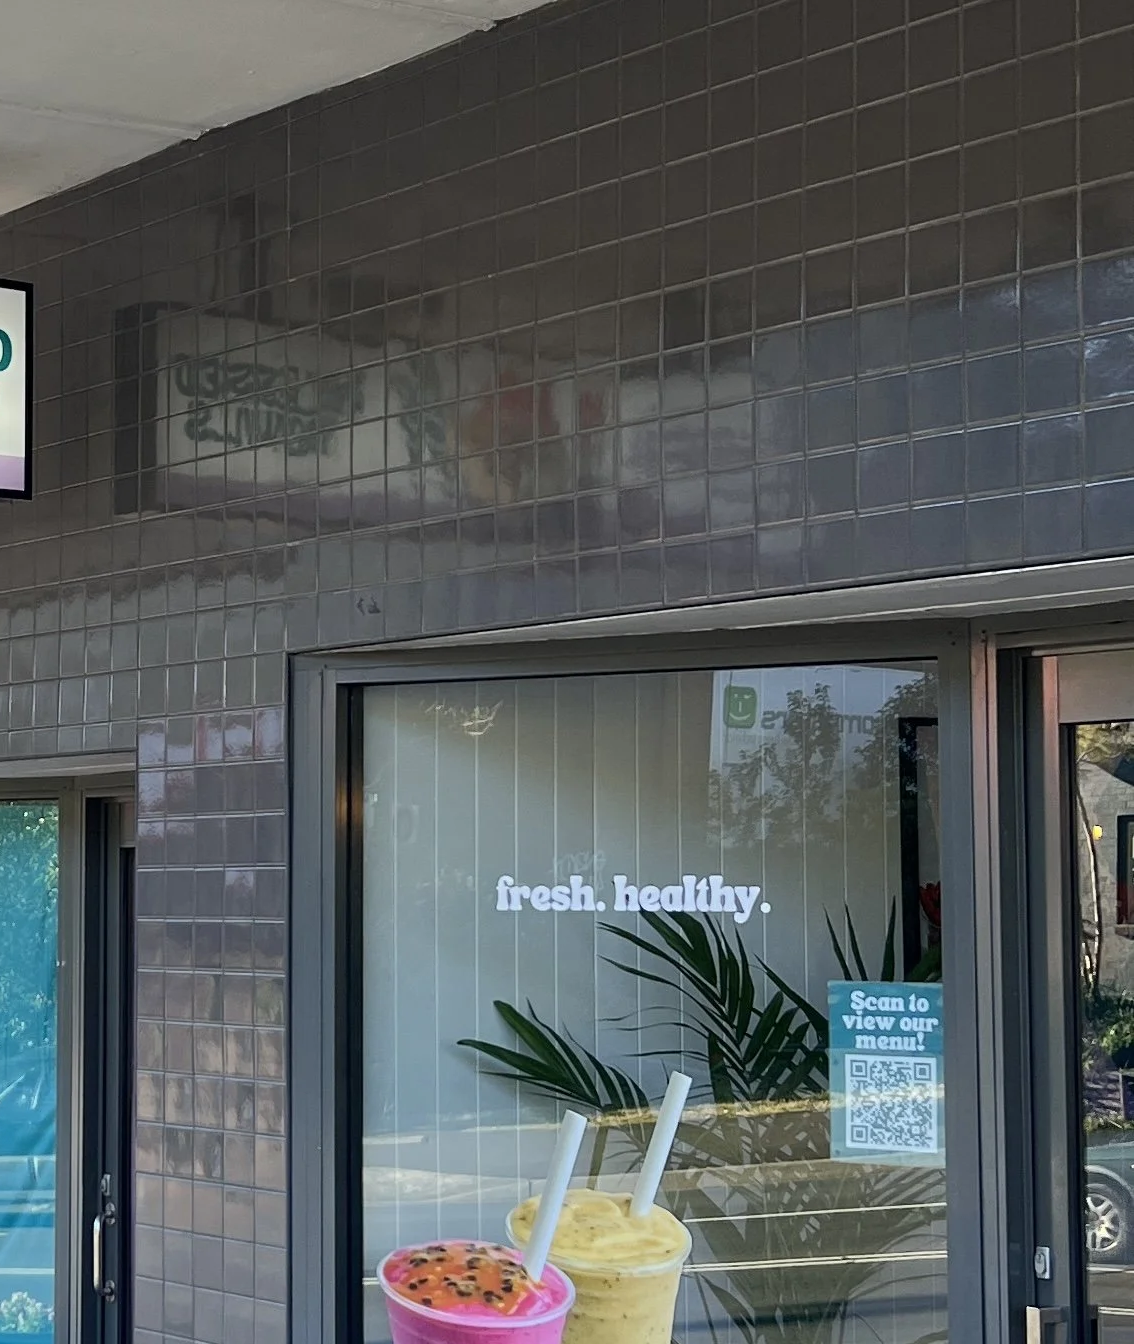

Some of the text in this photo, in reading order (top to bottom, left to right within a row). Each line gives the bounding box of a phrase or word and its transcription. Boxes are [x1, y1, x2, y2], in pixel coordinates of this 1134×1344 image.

[496, 874, 772, 924] fresh. healthy.
[850, 989, 930, 1013] Scan to
[841, 1009, 939, 1033] view our
[855, 1031, 925, 1052] menu!
